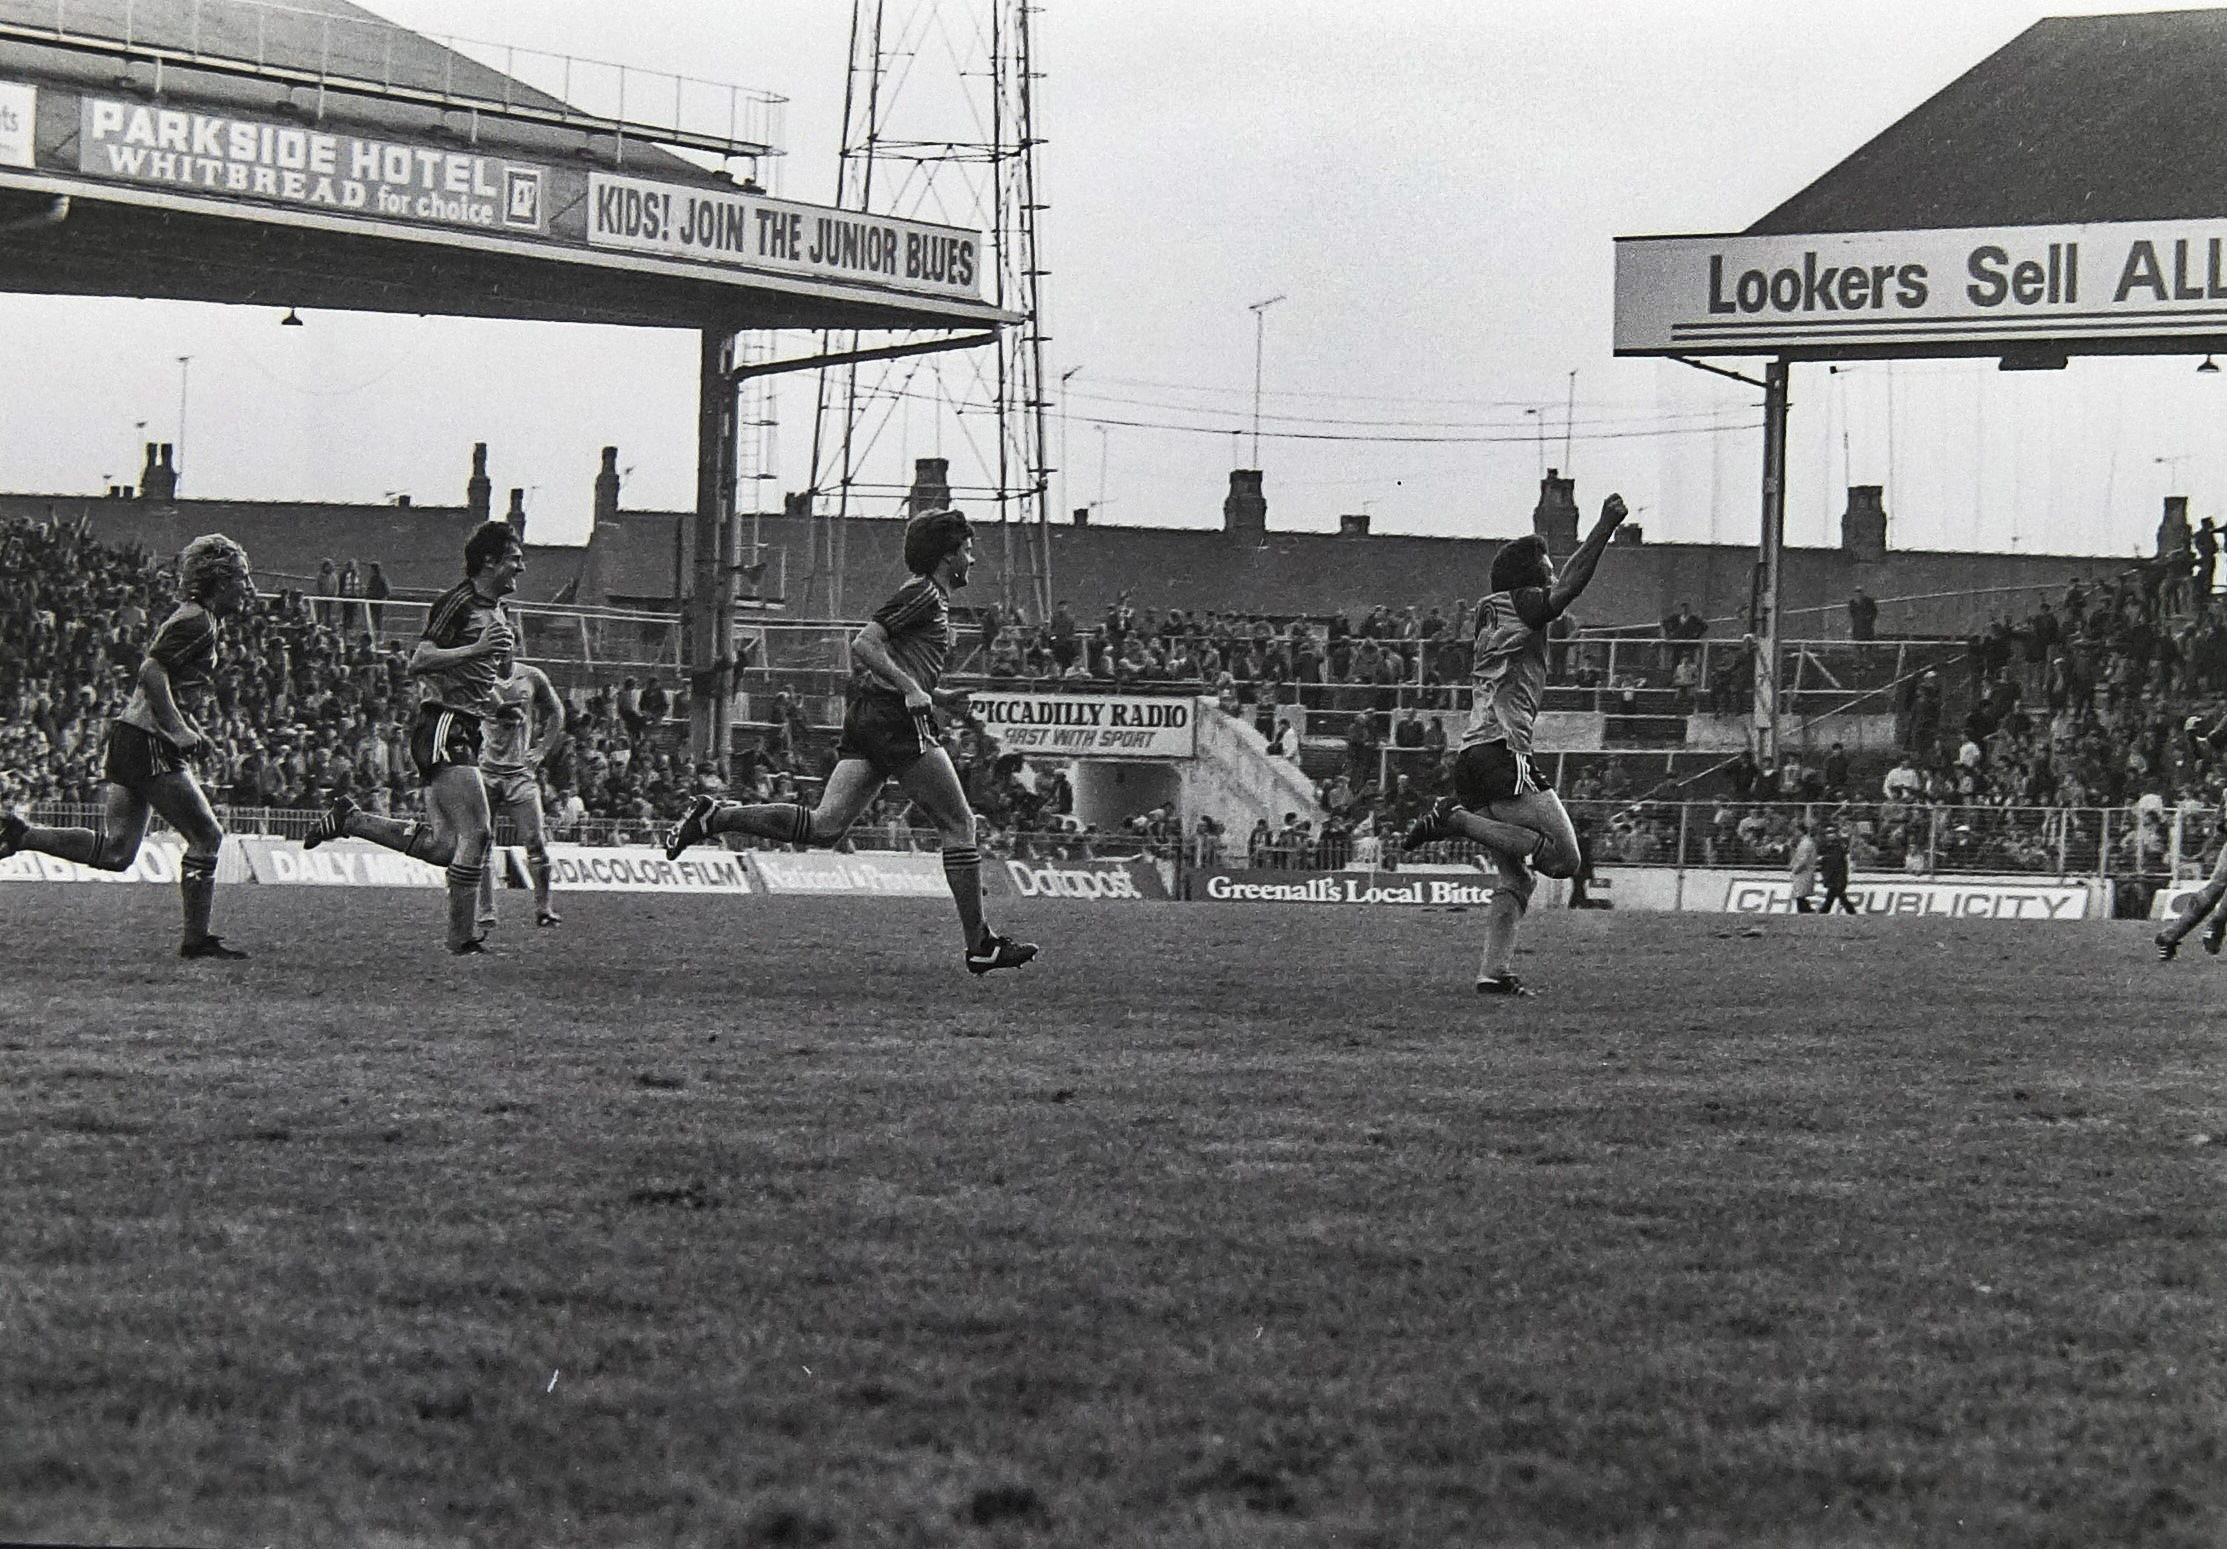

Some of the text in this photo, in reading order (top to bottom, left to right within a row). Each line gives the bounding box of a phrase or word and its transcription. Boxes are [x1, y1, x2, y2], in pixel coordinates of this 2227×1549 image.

[91, 100, 498, 199] PARKSIDE HOTEL
[106, 144, 494, 225] WHITBREAD for choice
[597, 184, 974, 285] KIDS! JOIN THE JUNIOR BLUES
[1708, 239, 2227, 314] Lookers Sell ALL
[971, 700, 1187, 728] PICCADILLY RADIO
[1053, 729, 1098, 747] WITH
[1098, 730, 1156, 748] SPORT
[270, 850, 357, 883] DAILY
[678, 860, 741, 887] FILM
[1346, 877, 1423, 904] Local
[1428, 881, 1494, 904] Bitte
[1838, 891, 2070, 918] PUBLICITY
